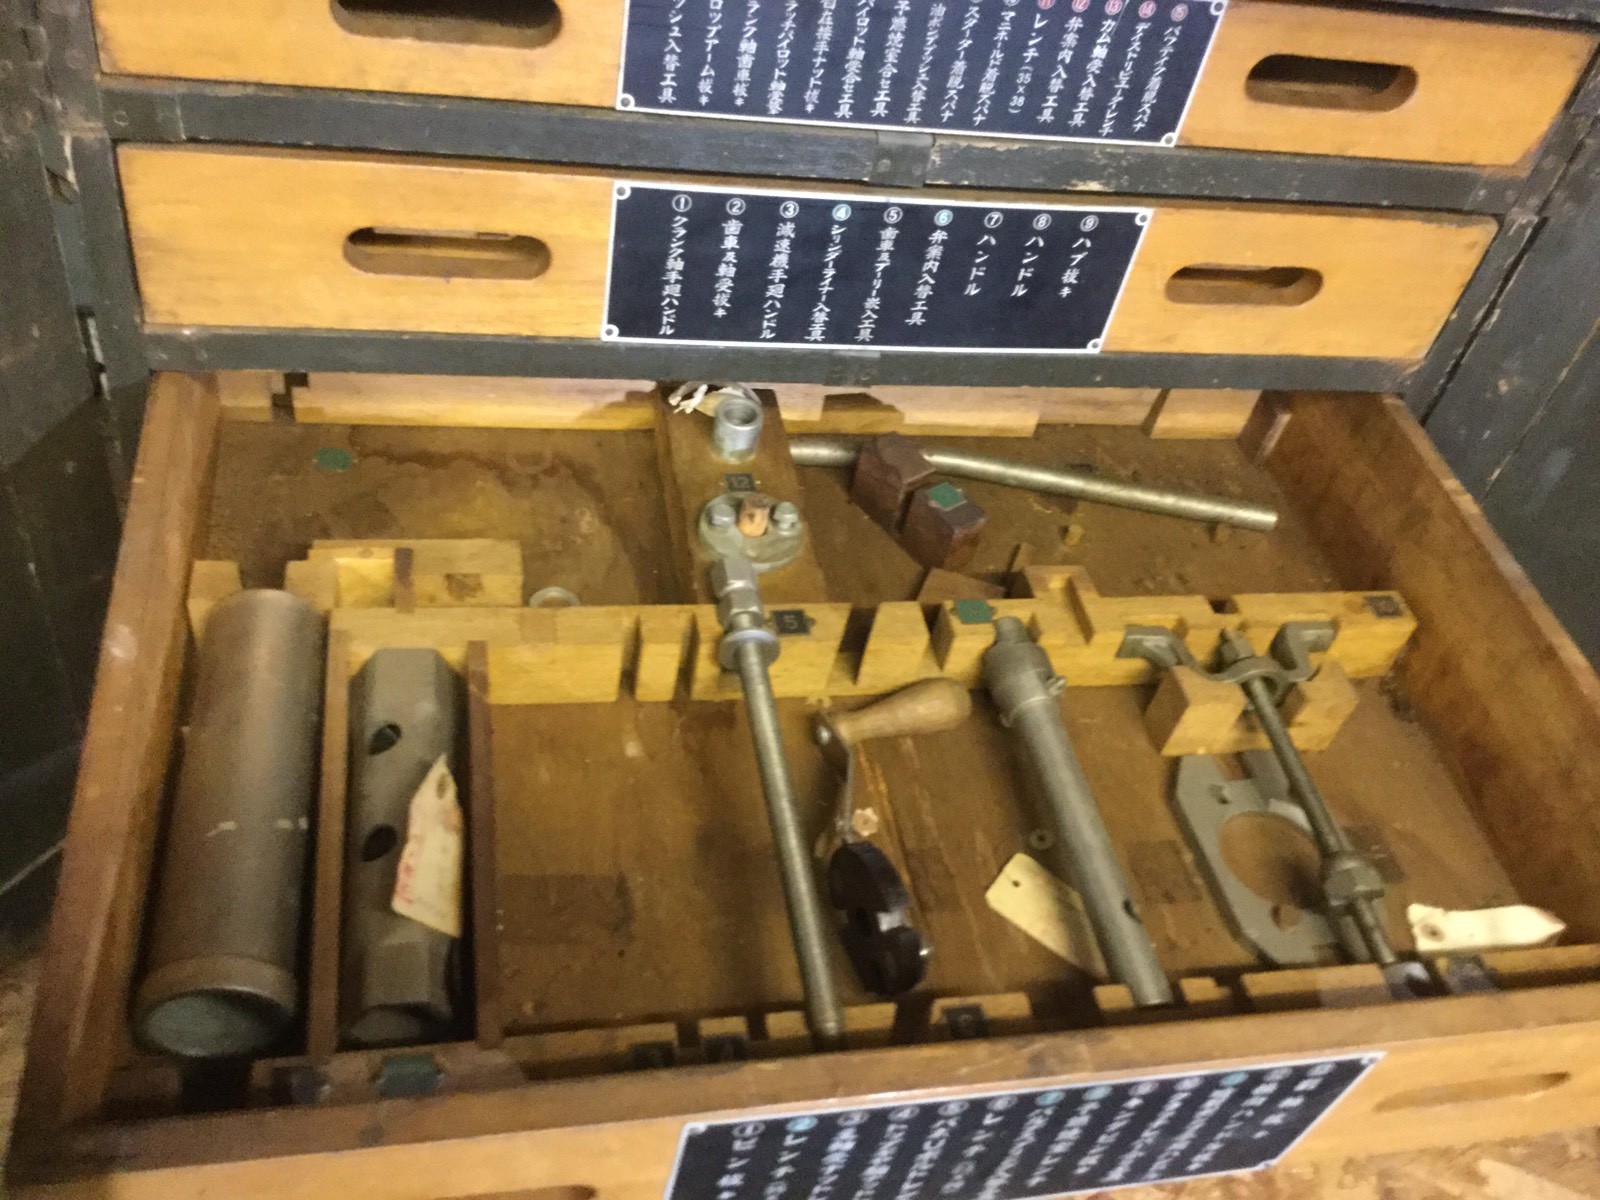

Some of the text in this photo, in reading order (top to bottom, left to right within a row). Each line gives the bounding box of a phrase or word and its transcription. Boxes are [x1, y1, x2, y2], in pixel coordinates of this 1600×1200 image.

[964, 235, 996, 296] ハンドル
[1010, 237, 1044, 297] ハンドル
